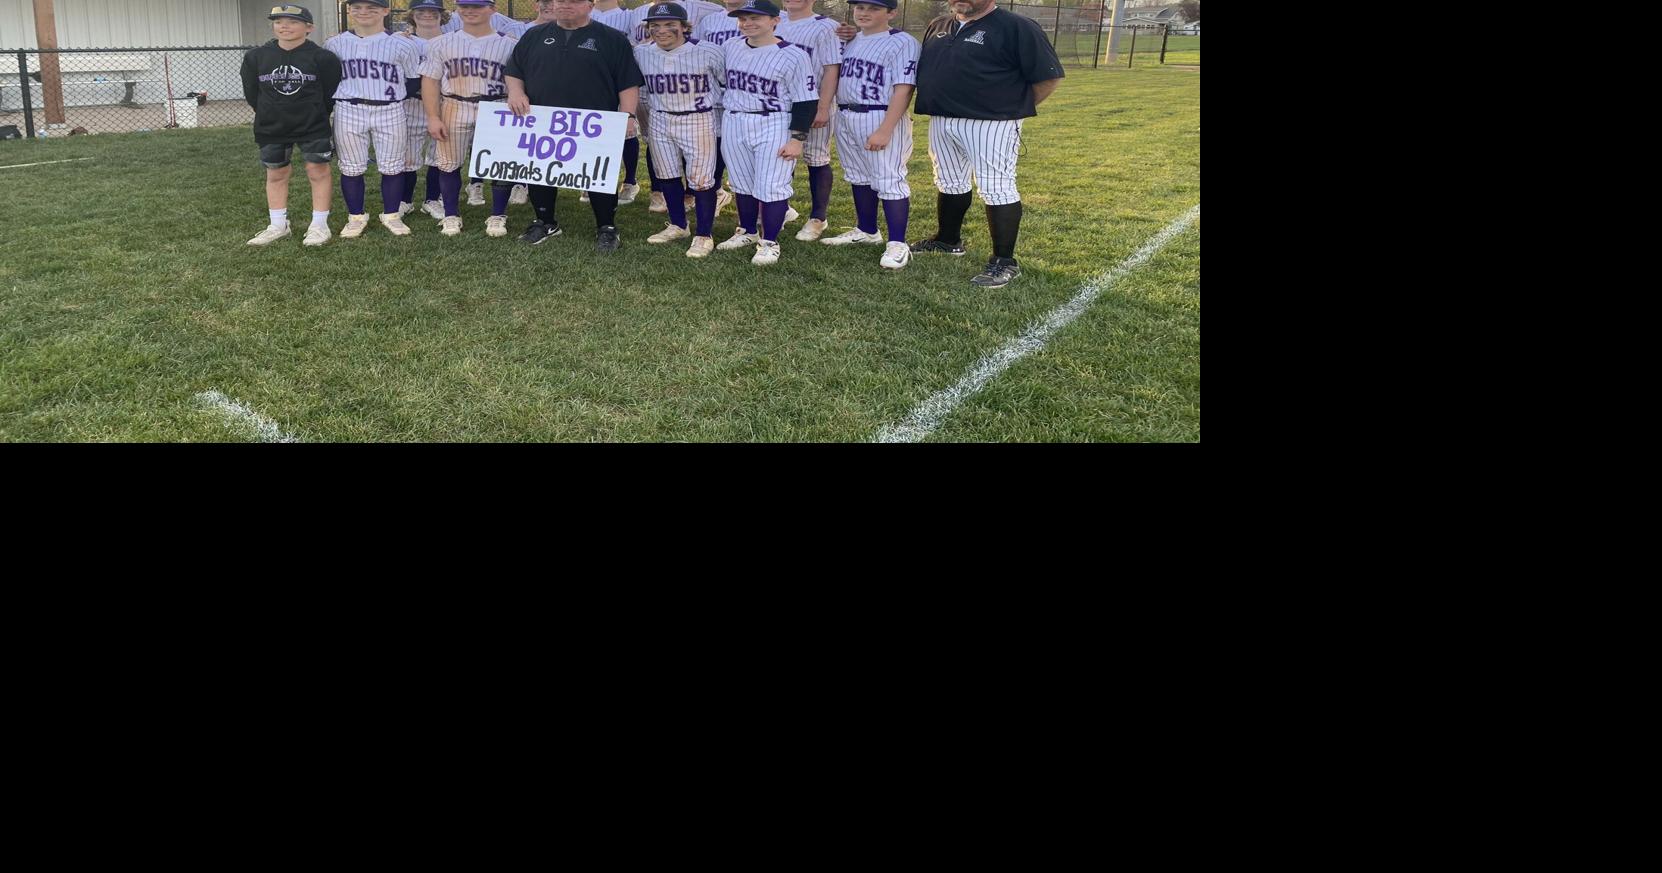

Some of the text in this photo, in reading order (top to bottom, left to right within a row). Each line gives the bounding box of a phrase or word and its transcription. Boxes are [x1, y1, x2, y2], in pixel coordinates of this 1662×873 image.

[341, 58, 399, 84] UGUSTA
[644, 73, 710, 94] UGUSTA
[384, 86, 396, 100] 4
[861, 85, 880, 101] 13
[494, 110, 602, 138] The BIG
[517, 133, 577, 162] 400
[475, 149, 543, 182] Congrats
